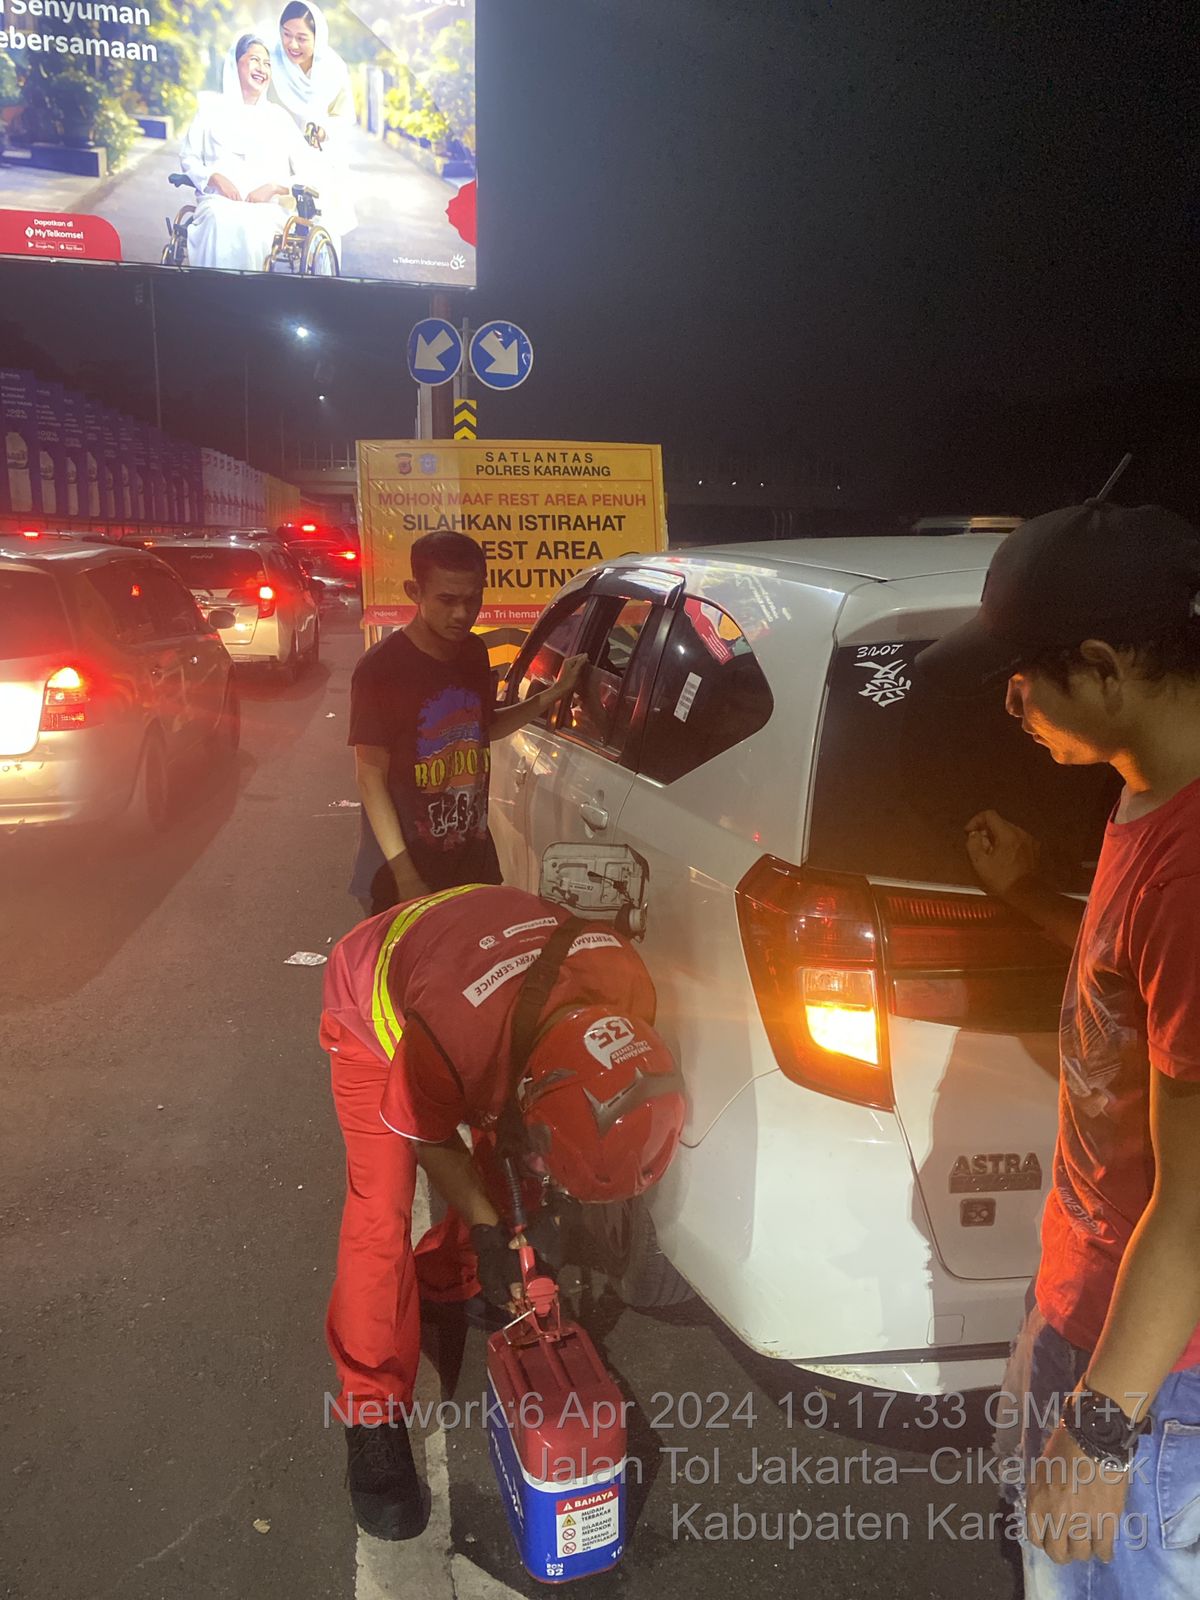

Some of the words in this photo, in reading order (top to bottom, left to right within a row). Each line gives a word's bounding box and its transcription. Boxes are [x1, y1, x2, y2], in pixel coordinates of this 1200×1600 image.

[11, 0, 150, 26] Senyuman
[0, 26, 157, 62] ebersamaan
[33, 219, 65, 227] Dapatkan
[35, 229, 84, 239] MyTelkomsel
[485, 452, 593, 463] SATLANTAS
[476, 465, 530, 476] POLRES
[534, 465, 611, 477] KARAWANG
[379, 493, 443, 506] MOHON
[447, 493, 493, 506] MAAF
[498, 493, 539, 506] REST
[544, 493, 587, 506] AREA
[592, 494, 646, 506] PENUH
[403, 514, 511, 531] SILAHKAN
[519, 514, 626, 531] ISTIRAHAT
[482, 540, 528, 560] EST
[536, 541, 603, 560] AREA
[494, 609, 506, 619] Tri
[857, 644, 903, 658] LOVE
[853, 660, 911, 707] 愛
[474, 963, 515, 997] SERVICE
[949, 1152, 1042, 1177] ASTRA
[574, 1490, 614, 1508] BAHAYA
[581, 1506, 604, 1516] MUDAH
[581, 1509, 611, 1522] TERBAKAR
[582, 1524, 611, 1536] MEROKOK
